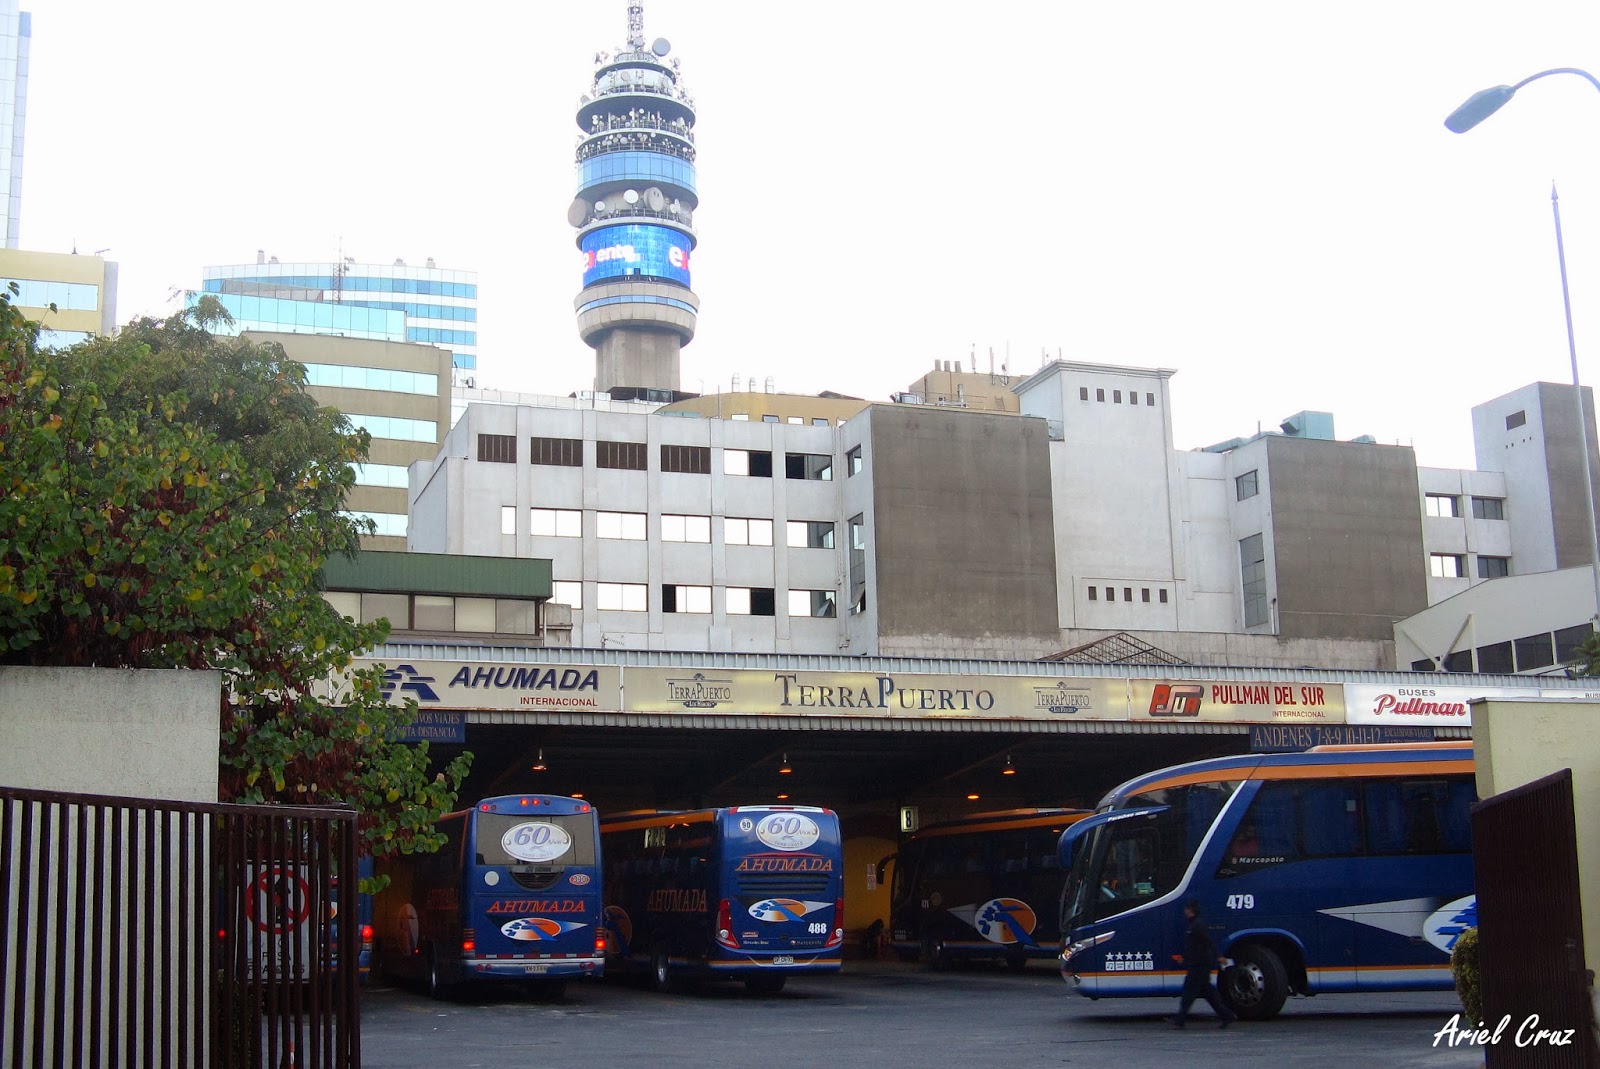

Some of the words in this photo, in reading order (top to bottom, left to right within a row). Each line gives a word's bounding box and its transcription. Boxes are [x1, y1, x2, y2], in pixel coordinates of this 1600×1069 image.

[448, 666, 599, 691] AHUMADA
[1212, 685, 1270, 705] PULLMAN
[1274, 686, 1297, 705] DEL
[1301, 687, 1325, 706] SUR
[1398, 688, 1436, 697] BUSES
[520, 697, 598, 707] INTERNACIONAL
[1373, 693, 1467, 716] Pullman
[434, 713, 460, 724] VIAJES
[418, 726, 457, 738] DISTANCIA
[1254, 726, 1313, 748] ANDENES
[1315, 727, 1341, 745] 7-8-9
[1345, 727, 1380, 744] 10-11-12
[742, 821, 751, 829] 90
[767, 816, 801, 835] 60
[905, 810, 912, 828] 8
[514, 826, 551, 845] 60
[735, 859, 833, 872] AHUMADA
[1238, 856, 1285, 864] Marcopolo
[486, 900, 586, 913] AHUMADA
[647, 888, 708, 912] AHUMADA
[1226, 894, 1255, 909] 479
[808, 922, 827, 934] 488
